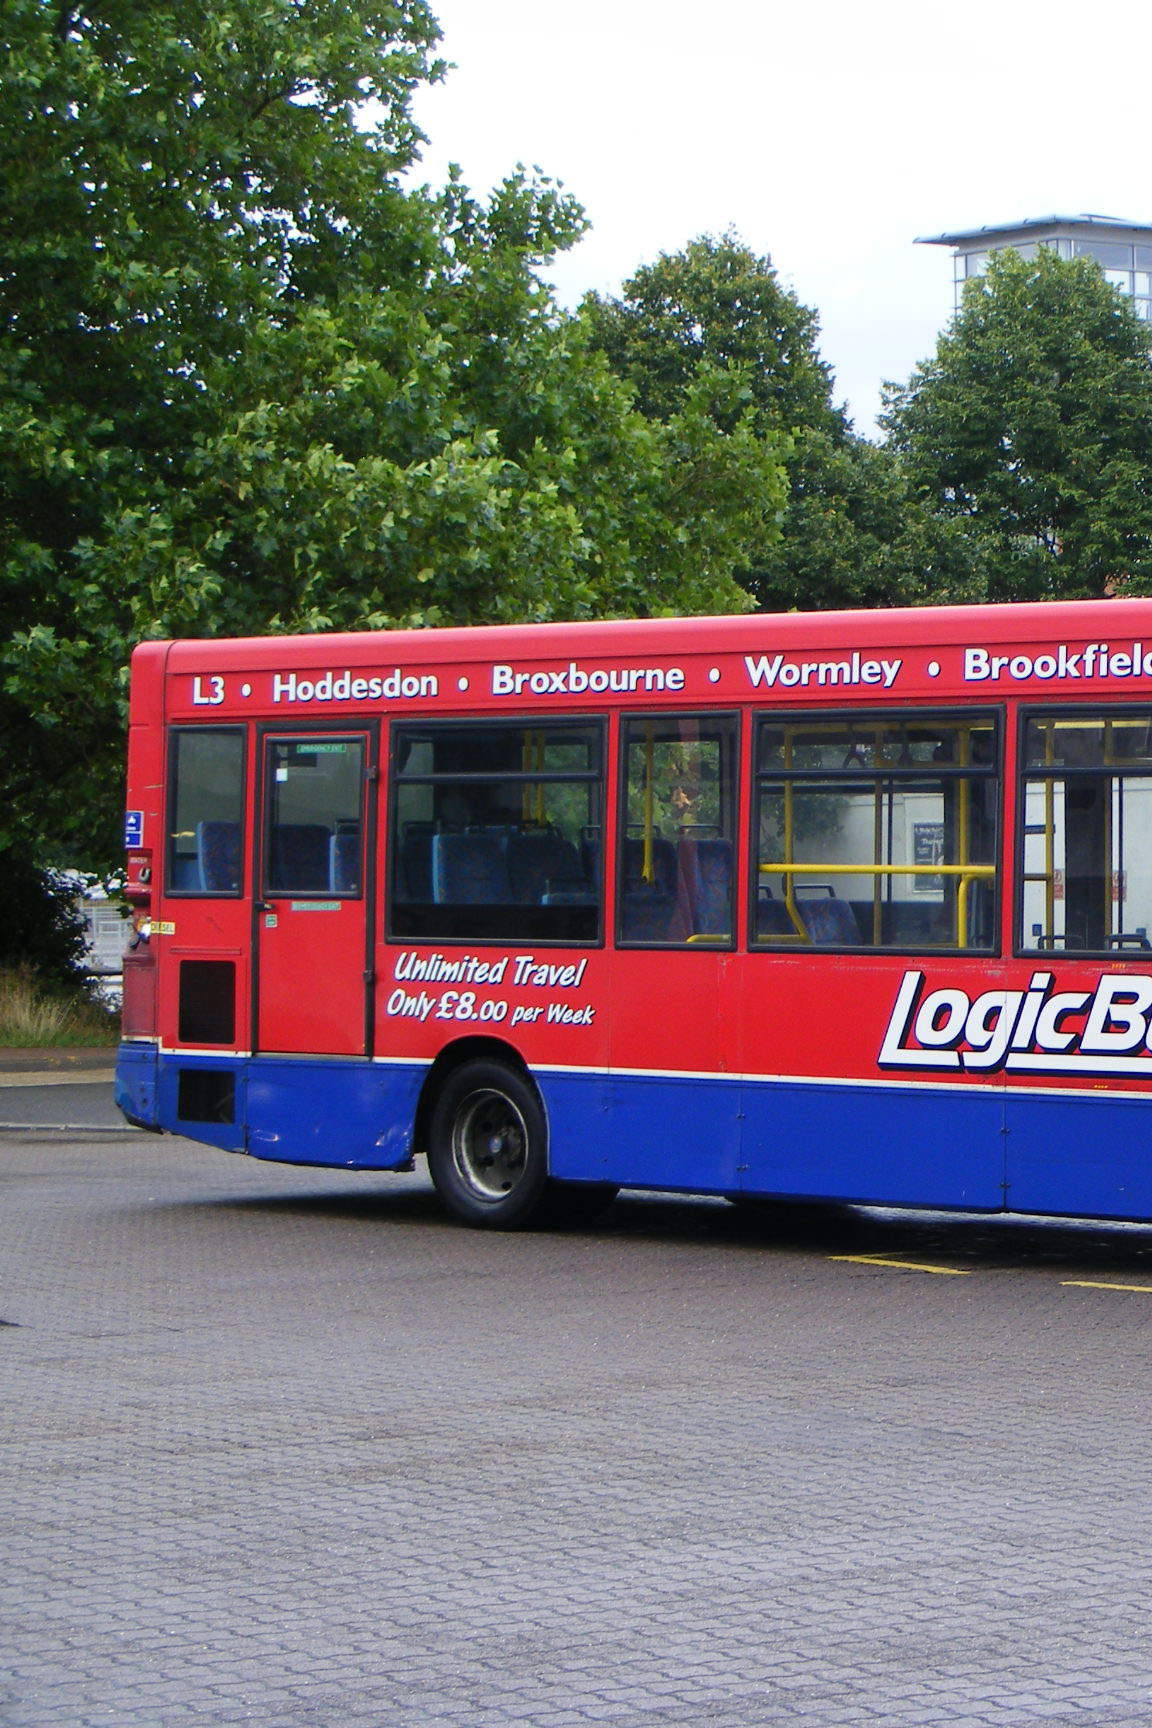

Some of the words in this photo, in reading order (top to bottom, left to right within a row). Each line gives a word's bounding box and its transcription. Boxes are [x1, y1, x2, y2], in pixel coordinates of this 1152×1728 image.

[193, 676, 225, 704] L3
[273, 669, 438, 702] Hoddesdon
[492, 663, 685, 695] Broxbourne
[745, 653, 902, 688] Wormley
[394, 952, 509, 985] Unlimited
[513, 955, 588, 987] Travel
[386, 988, 436, 1022] Only
[435, 990, 508, 1021] £8.00
[511, 1005, 543, 1026] per
[546, 1003, 596, 1025] Week
